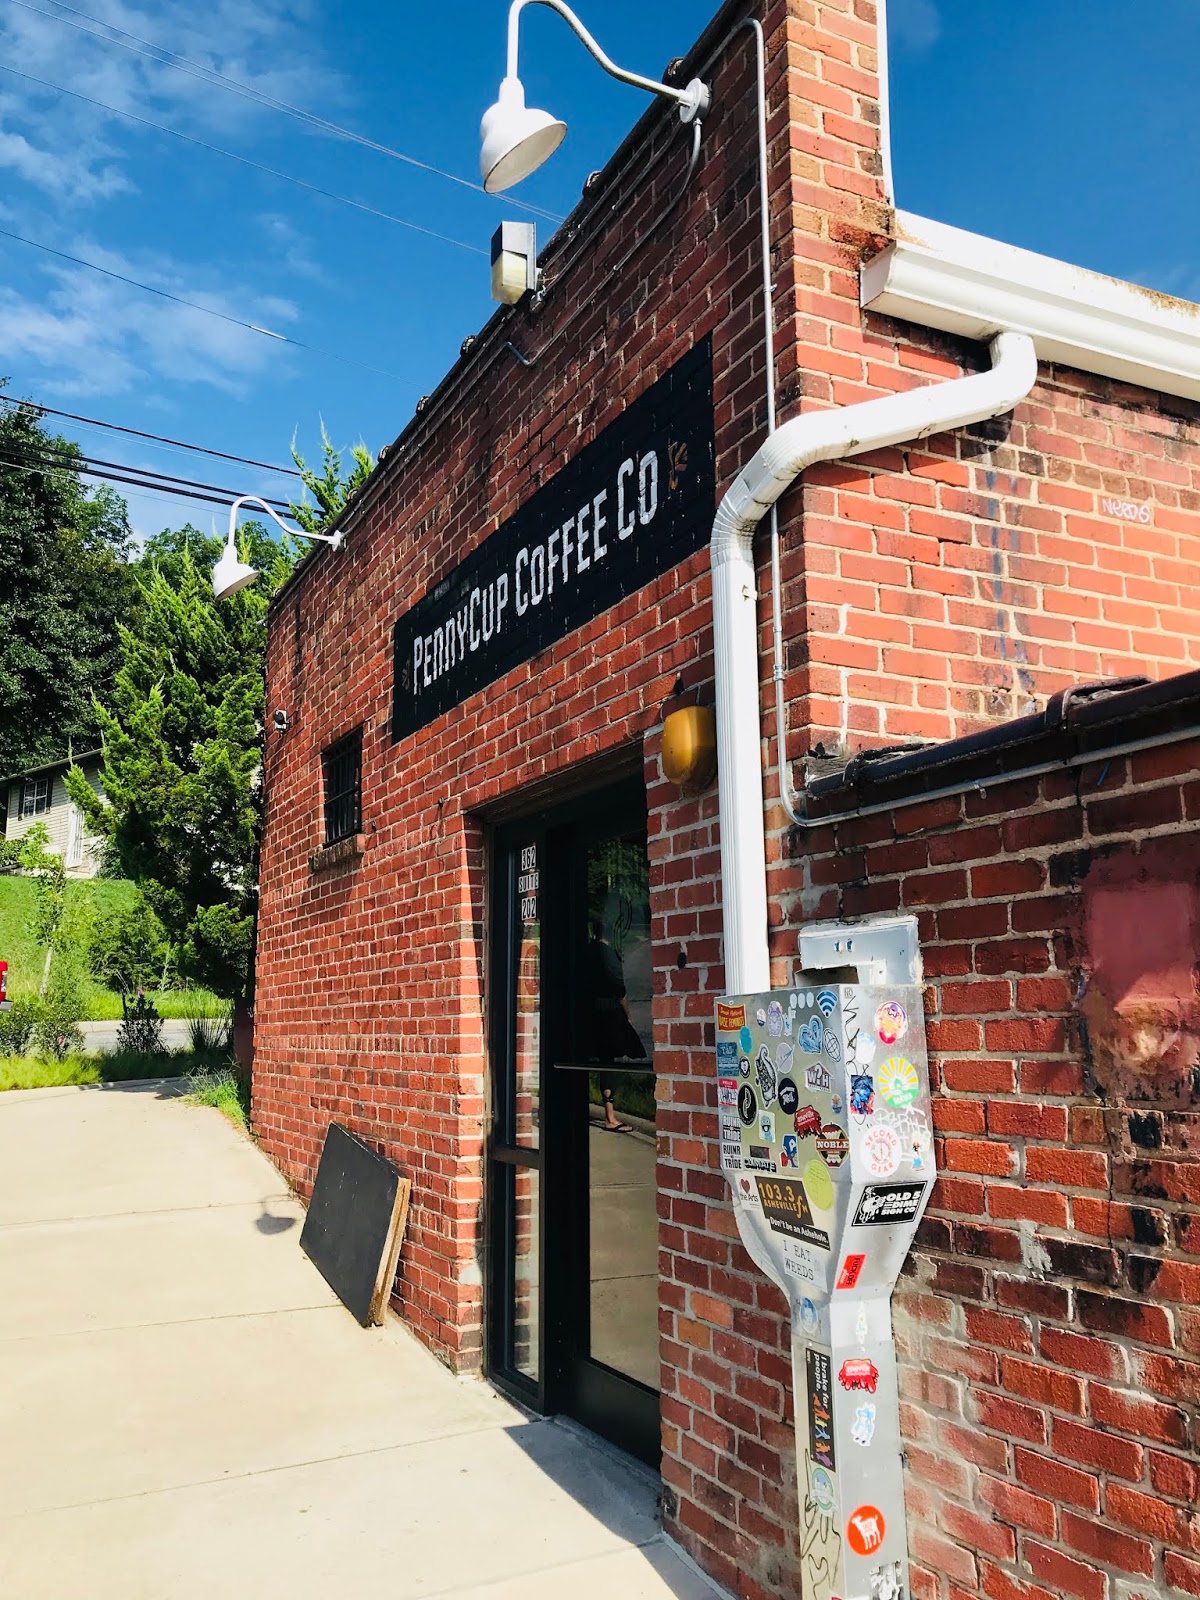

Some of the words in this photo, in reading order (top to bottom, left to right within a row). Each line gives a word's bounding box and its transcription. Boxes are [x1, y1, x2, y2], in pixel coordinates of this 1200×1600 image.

[515, 489, 608, 617] COFFEE
[617, 450, 659, 541] CO
[522, 847, 536, 870] 362
[519, 873, 539, 891] SUITE
[522, 897, 536, 919] 202
[816, 1141, 849, 1149] NOBLE
[864, 1129, 897, 1146] SECOND
[871, 1161, 894, 1173] GEAR
[758, 1182, 795, 1202] 103.3
[886, 1192, 912, 1202] OLD
[911, 1190, 922, 1200] 5
[764, 1199, 798, 1212] ASHEVILLE
[881, 1207, 903, 1216] SIGN
[904, 1206, 916, 1214] CO
[892, 1199, 918, 1209] DIME
[769, 1216, 786, 1229] Don't
[785, 1222, 793, 1231] be
[783, 1239, 788, 1251] I
[793, 1244, 811, 1262] EAT
[850, 1257, 861, 1274] FUCK
[846, 1274, 855, 1286] OFF
[813, 1353, 822, 1392] people.
